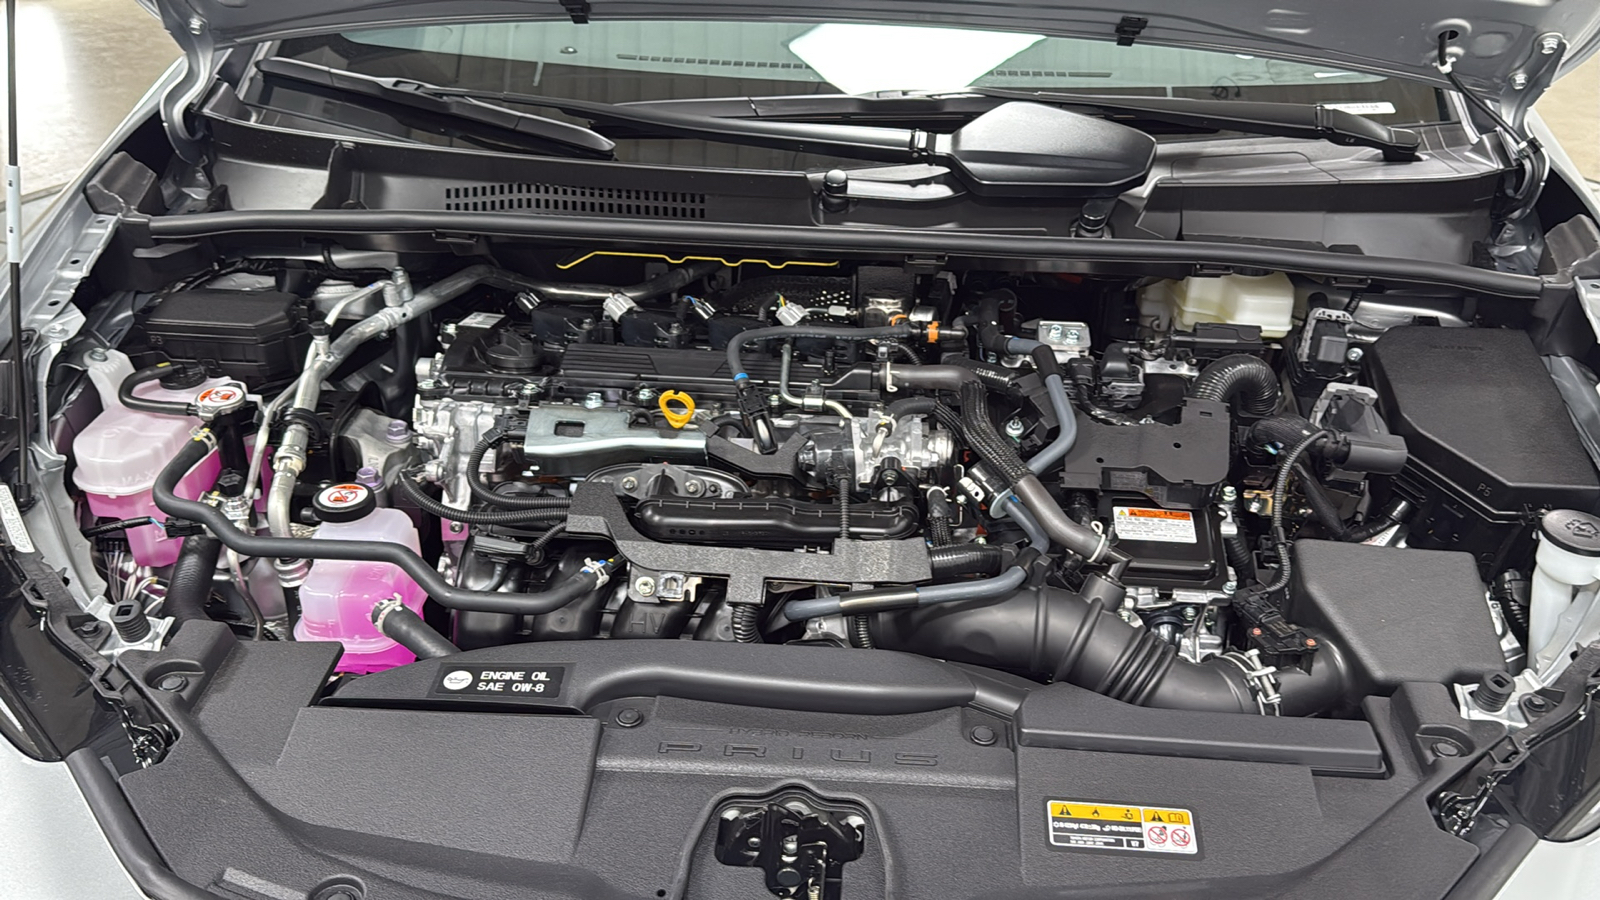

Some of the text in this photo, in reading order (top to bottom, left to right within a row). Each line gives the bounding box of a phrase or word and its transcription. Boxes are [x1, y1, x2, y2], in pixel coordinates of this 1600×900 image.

[1476, 482, 1492, 497] P5
[628, 612, 666, 634] HV
[480, 671, 551, 681] ENGINE OIL
[477, 682, 545, 693] SAE 0W-8
[729, 726, 869, 741] HYBRID REBORN
[657, 740, 938, 767] PRIUS
